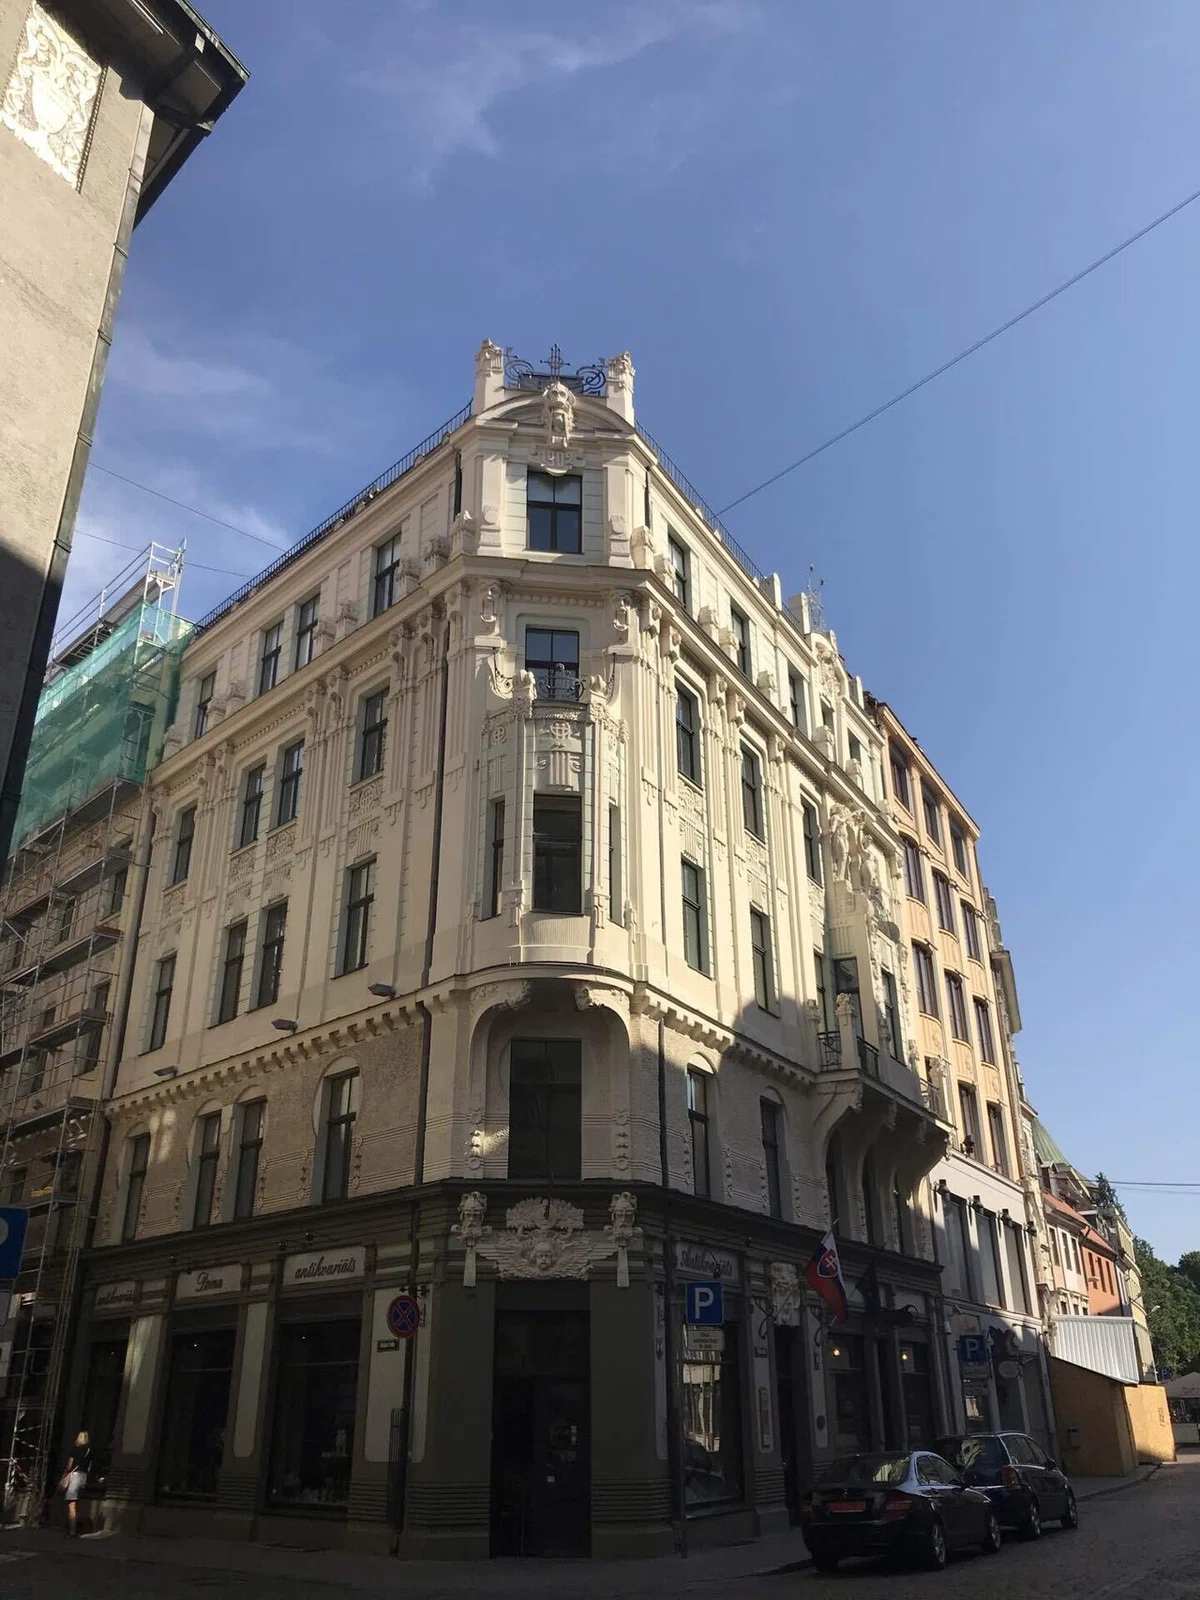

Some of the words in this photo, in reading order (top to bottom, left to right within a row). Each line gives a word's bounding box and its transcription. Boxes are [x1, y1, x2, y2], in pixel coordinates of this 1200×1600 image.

[295, 1256, 356, 1280] antikvariāts
[694, 1287, 714, 1320] P
[965, 1338, 980, 1360] P
